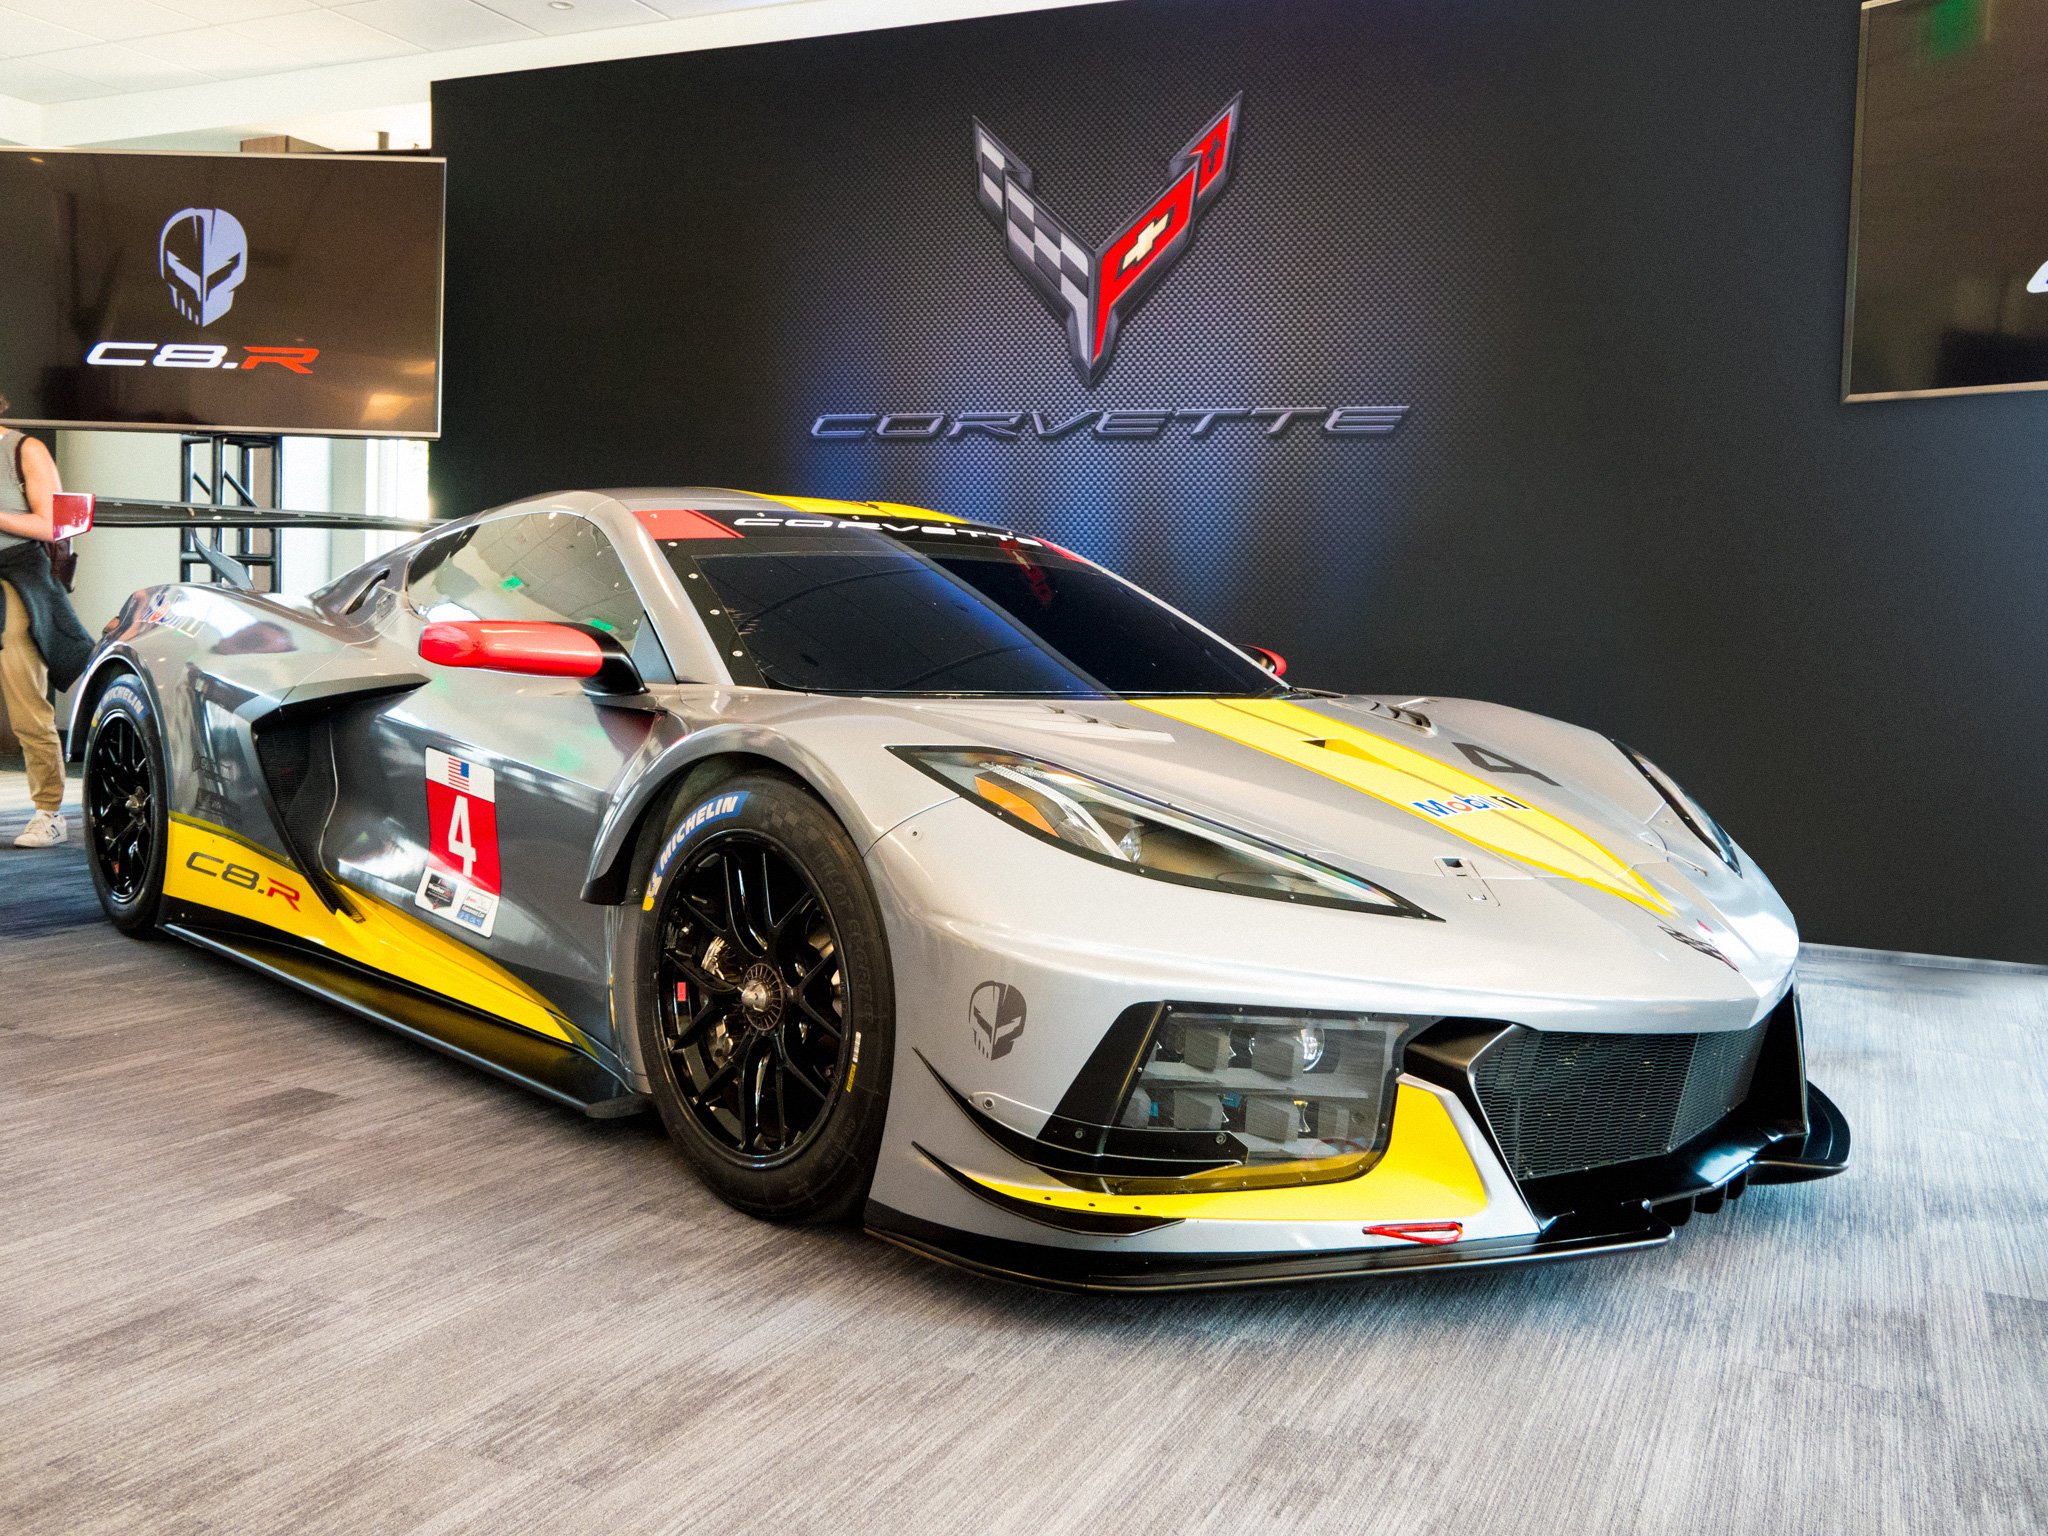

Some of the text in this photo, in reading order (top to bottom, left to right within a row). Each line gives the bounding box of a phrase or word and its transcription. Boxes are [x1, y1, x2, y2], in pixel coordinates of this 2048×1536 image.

[85, 341, 320, 375] C8.R
[809, 404, 1411, 439] CORVETTE
[733, 517, 1043, 547] CORVETTE
[103, 685, 145, 715] MICHELIN
[1451, 741, 1564, 788] 4
[447, 794, 477, 878] 4
[659, 795, 739, 871] MICHELIN
[186, 851, 301, 913] C8.R
